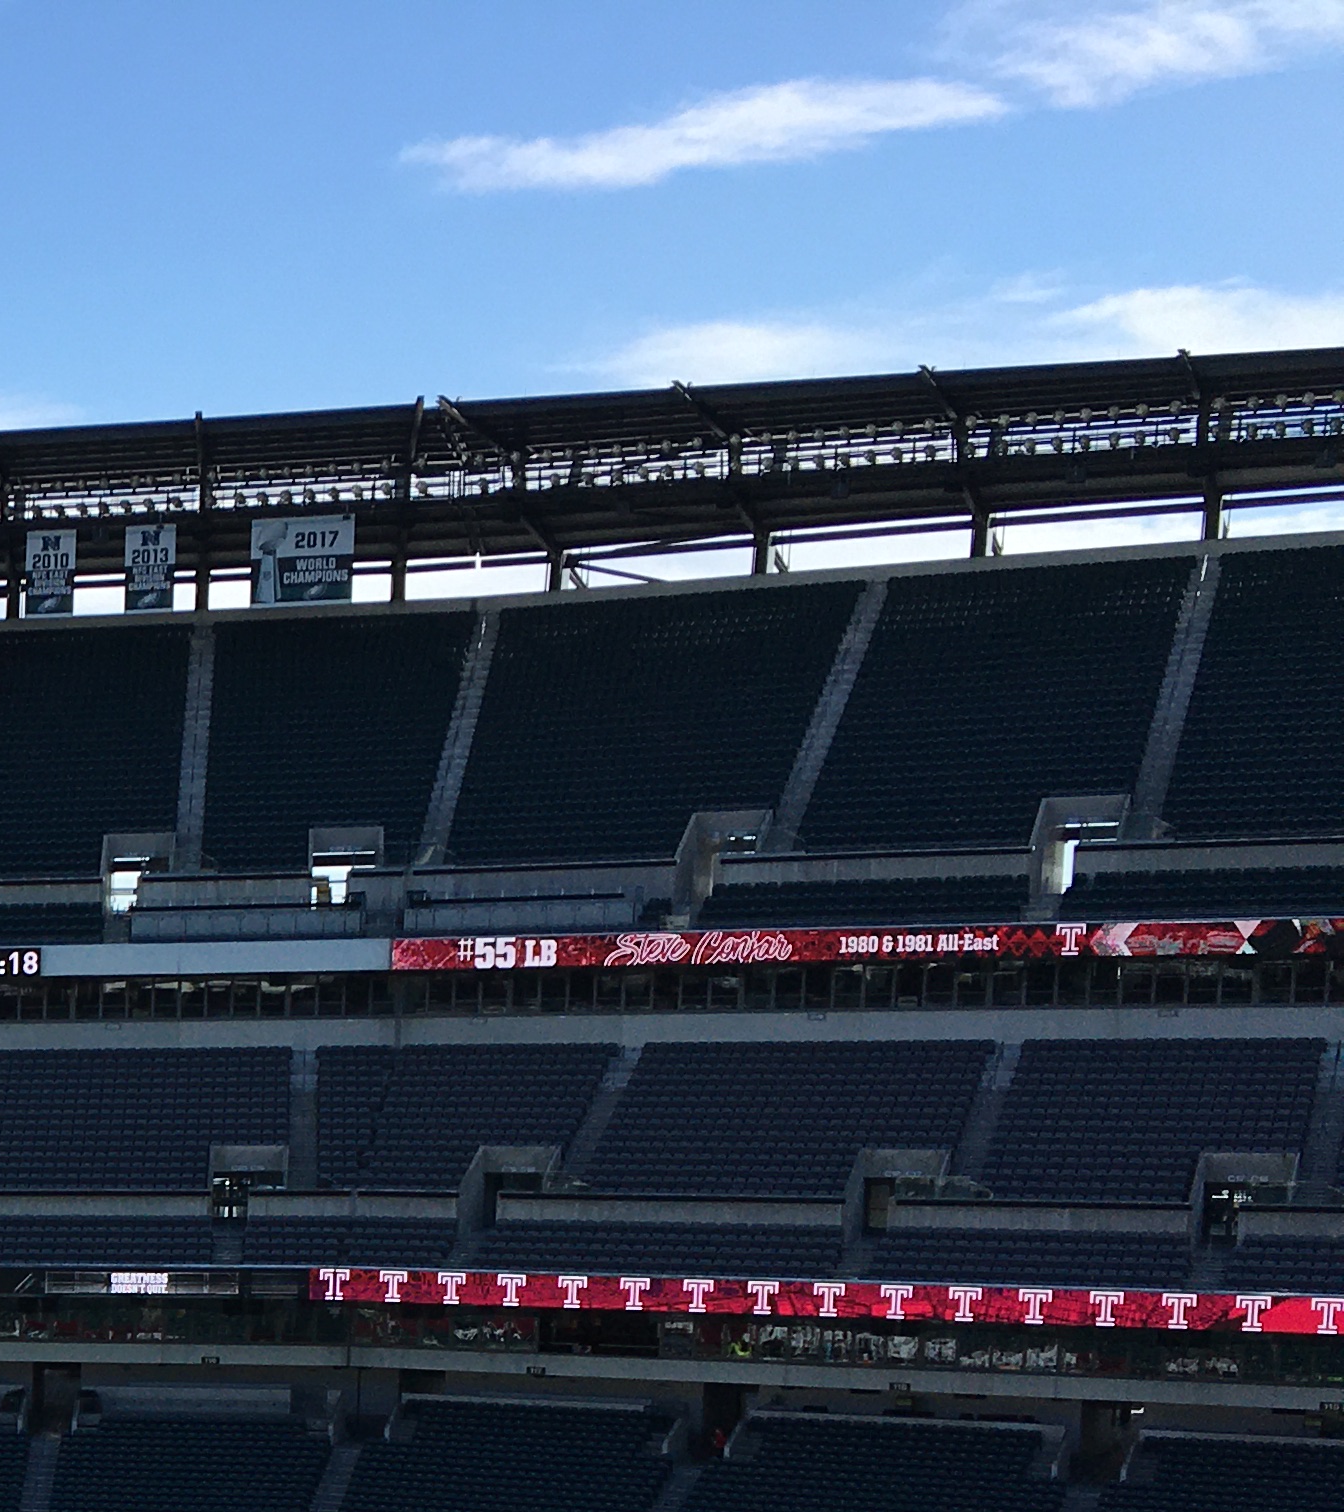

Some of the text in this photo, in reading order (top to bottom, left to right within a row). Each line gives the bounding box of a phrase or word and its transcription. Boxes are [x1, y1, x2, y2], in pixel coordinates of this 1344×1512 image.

[295, 530, 339, 549] 2017
[32, 553, 69, 569] 2010
[132, 548, 169, 564] 2013
[296, 557, 336, 571] WORLD
[283, 569, 349, 584] CHAMPIONS
[839, 935, 879, 954] 1980
[896, 934, 934, 953] 1981
[938, 933, 1000, 952] All-East
[457, 936, 557, 969] #55 LB
[111, 1272, 168, 1284] GREATNESS
